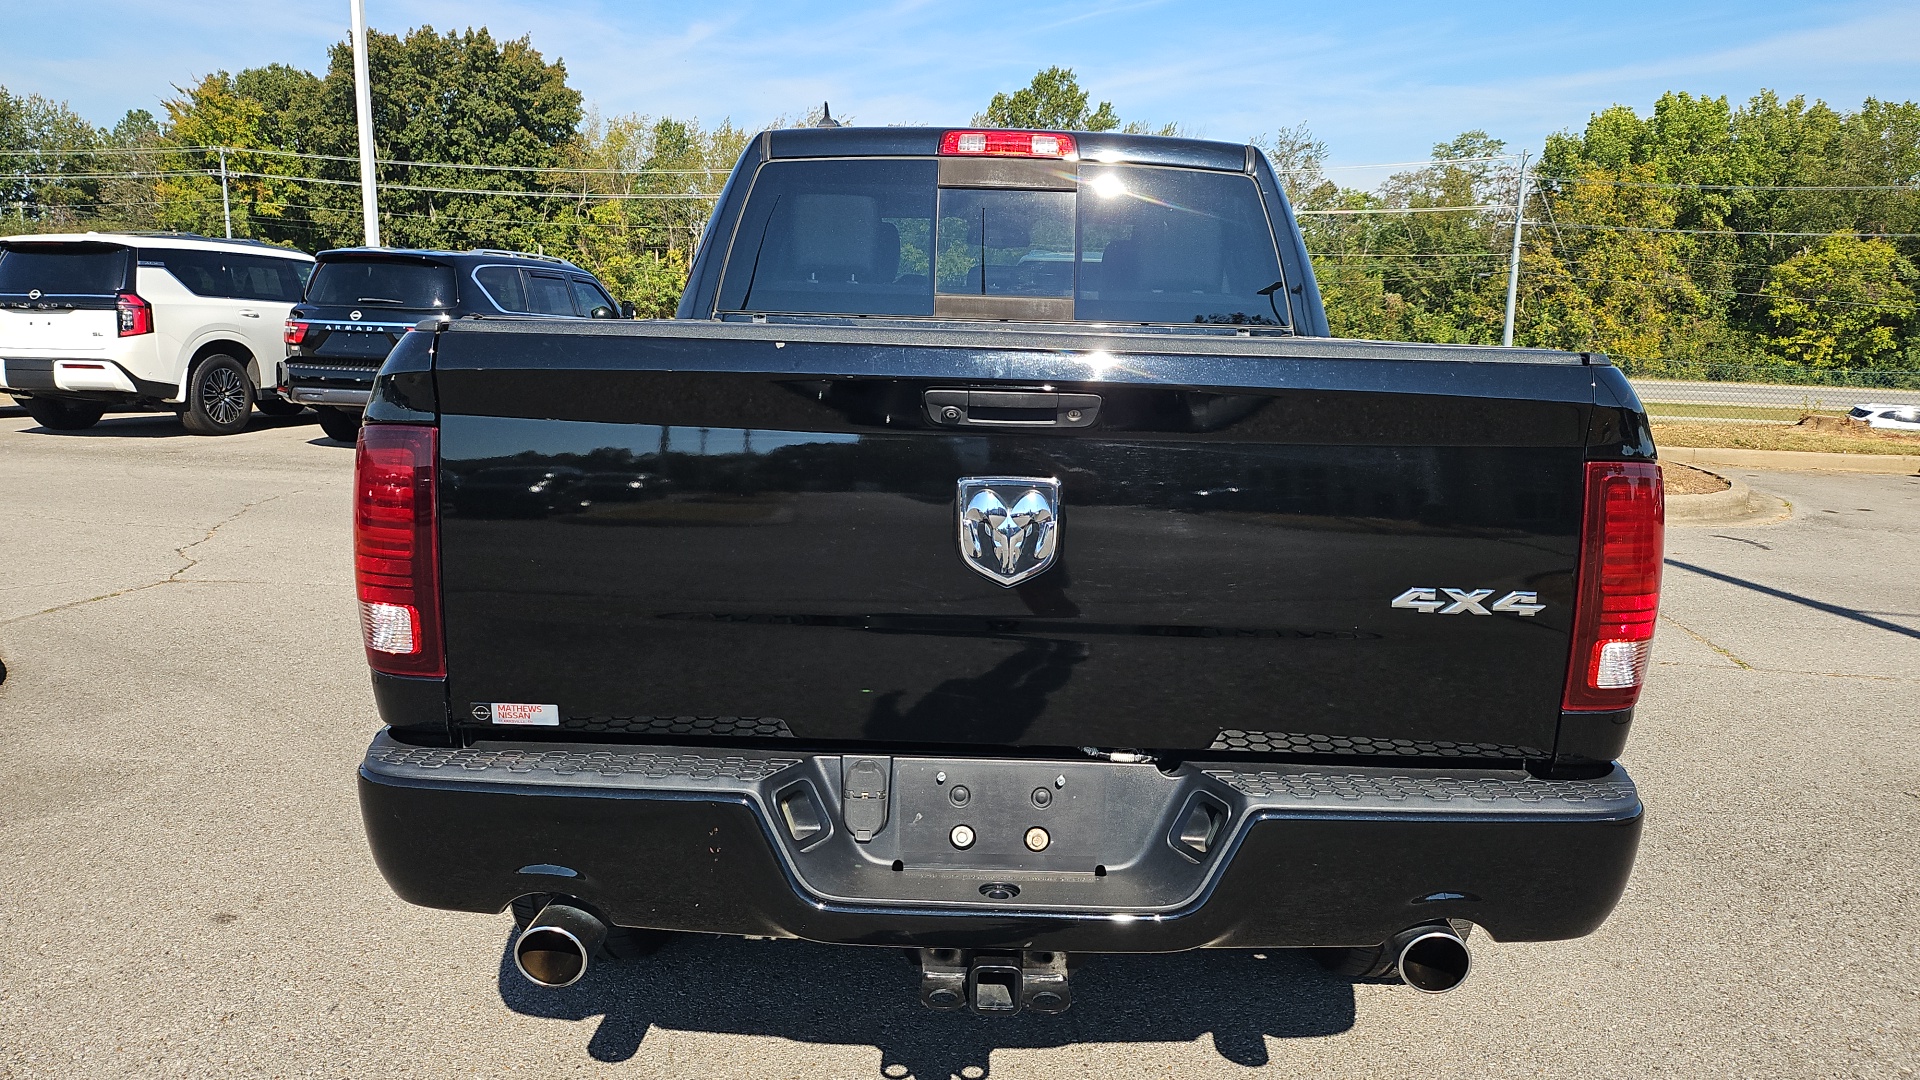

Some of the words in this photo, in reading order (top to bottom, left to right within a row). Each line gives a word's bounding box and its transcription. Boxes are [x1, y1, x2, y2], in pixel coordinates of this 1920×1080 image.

[325, 324, 384, 332] ARMADA
[1391, 586, 1547, 617] 4X4
[497, 705, 542, 713] MATHEWS
[498, 711, 531, 719] NISSAN
